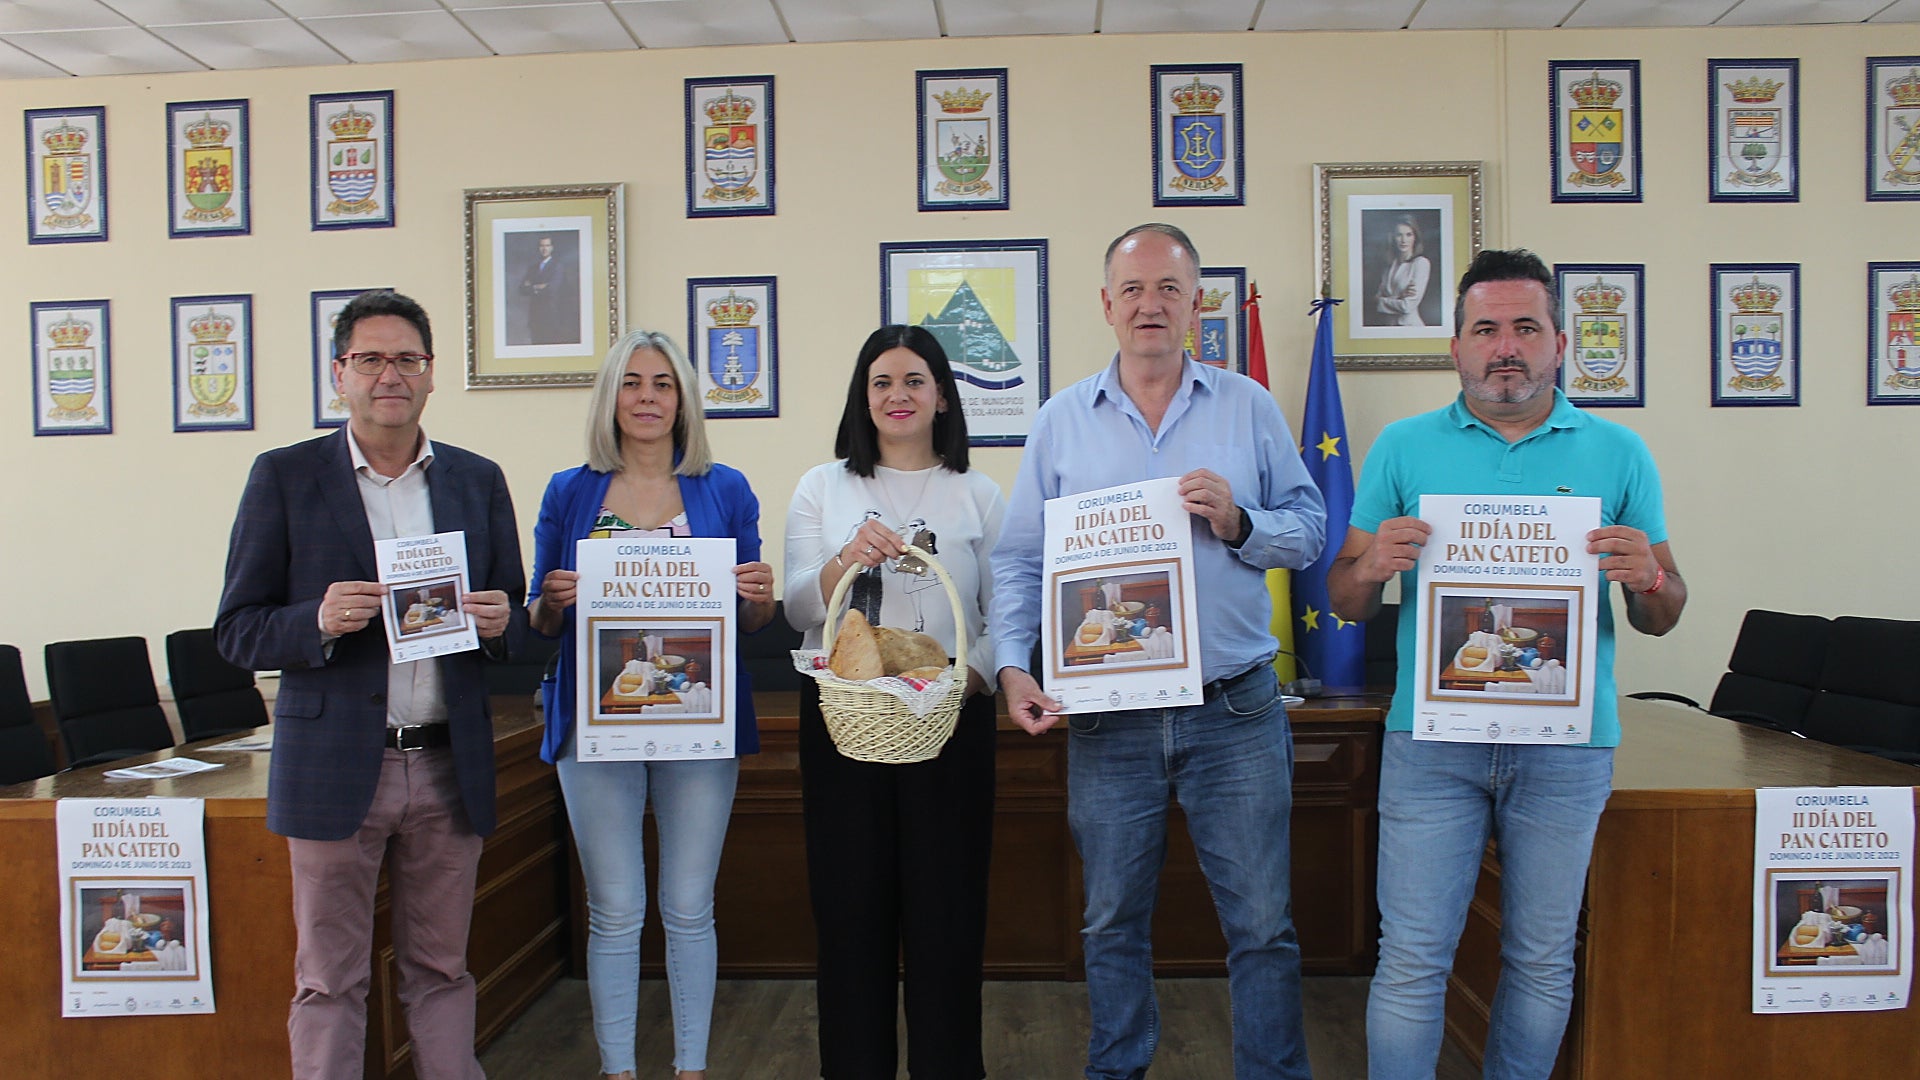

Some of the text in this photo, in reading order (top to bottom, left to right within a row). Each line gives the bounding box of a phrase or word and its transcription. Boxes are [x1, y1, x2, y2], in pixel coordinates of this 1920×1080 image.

[982, 397, 1024, 405] MUNICIPIOS
[1078, 490, 1143, 509] CORUMBELA
[1075, 505, 1151, 530] II DÍA DEL
[1464, 504, 1548, 516] CORUMBELA
[1461, 518, 1556, 540] II DÍA DEL
[397, 538, 439, 547] CORUMBELA
[1065, 523, 1164, 552] PAN CATETO
[397, 546, 445, 560] II DÍA DEL
[618, 545, 692, 556] CORUMBELA
[1055, 552, 1092, 564] DOMINGO
[1113, 546, 1138, 555] JUNIO
[1141, 544, 1152, 552] DE
[1155, 542, 1177, 551] 2023
[1446, 544, 1568, 564] PAN CATETO
[392, 556, 452, 572] PAN CATETO
[615, 559, 699, 576] II DÍA DEL
[1434, 565, 1582, 577] DOMINGO 4 DE JUNIO DE 2023
[603, 581, 711, 597] PAN CATETO
[591, 601, 634, 609] DOMINGO
[1796, 795, 1869, 806] CORUMBELA
[94, 807, 161, 816] CORUMBELA
[1793, 809, 1877, 828] II DÍA DEL
[93, 819, 168, 837] II DÍA DEL
[1781, 832, 1888, 848] PAN CATETO
[82, 842, 180, 857] PAN CATETO
[1770, 852, 1812, 860] DOMINGO
[1814, 852, 1820, 860] 4
[1822, 852, 1832, 860] DE
[1835, 852, 1861, 860] JUNIO
[72, 861, 112, 869] DOMINGO
